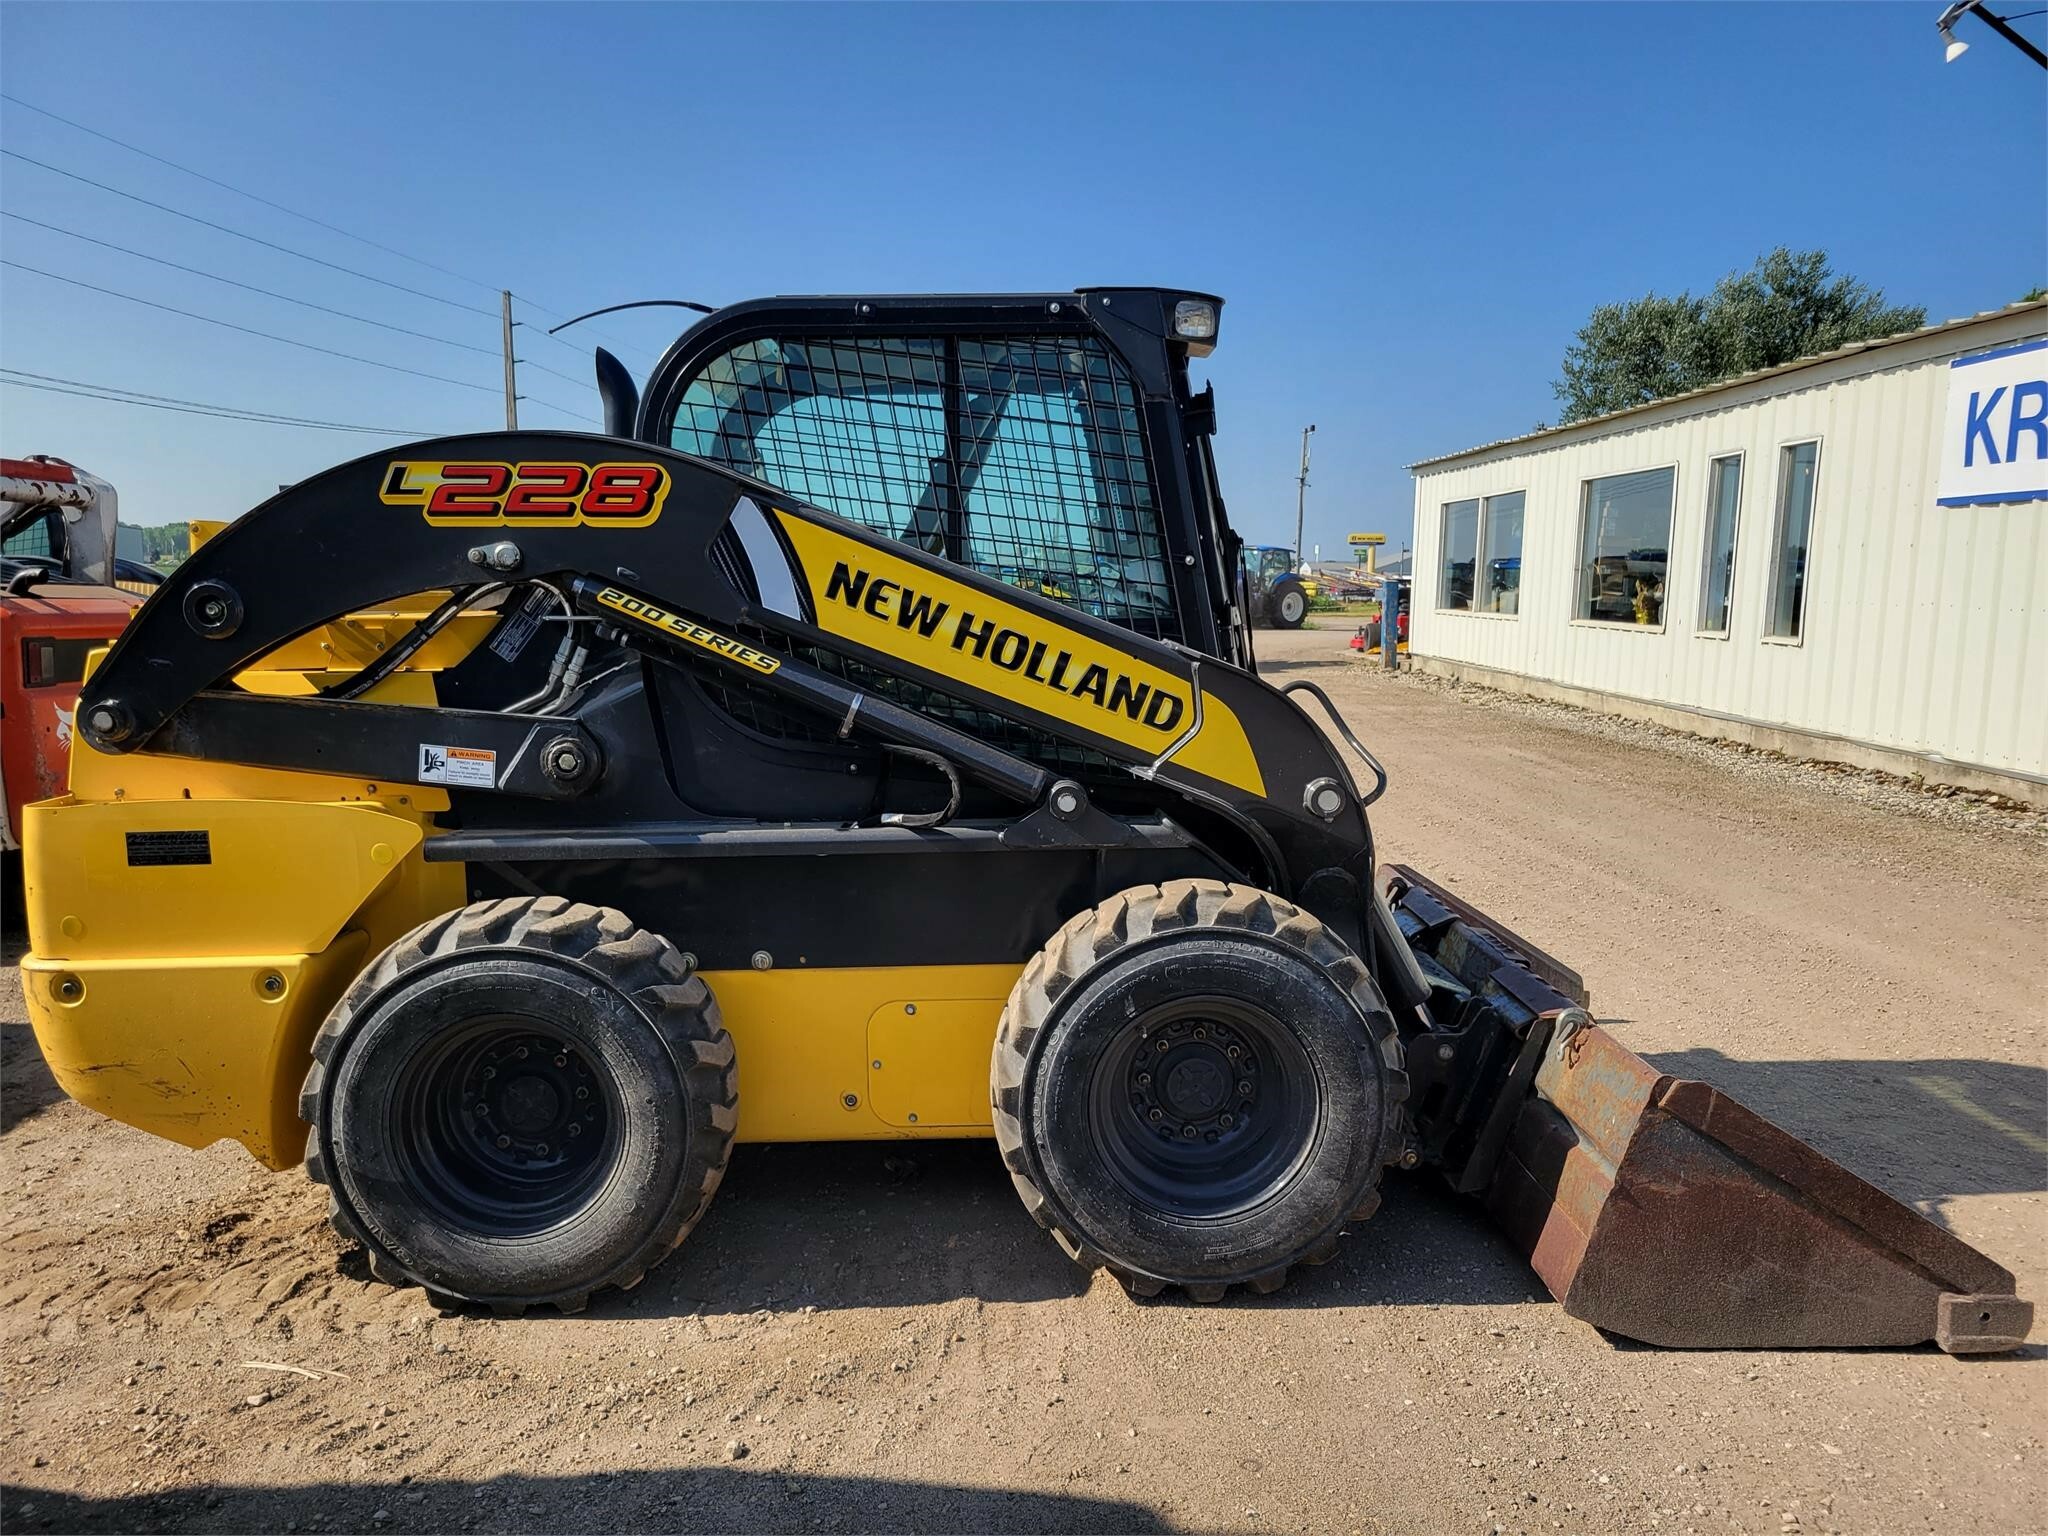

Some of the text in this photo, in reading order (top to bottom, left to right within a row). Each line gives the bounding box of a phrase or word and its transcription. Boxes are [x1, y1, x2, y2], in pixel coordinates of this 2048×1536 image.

[1964, 380, 2048, 468] KR
[600, 589, 778, 670] 200 SERIES
[823, 560, 1185, 732] NEW HOLLAND
[458, 751, 491, 760] WARNING
